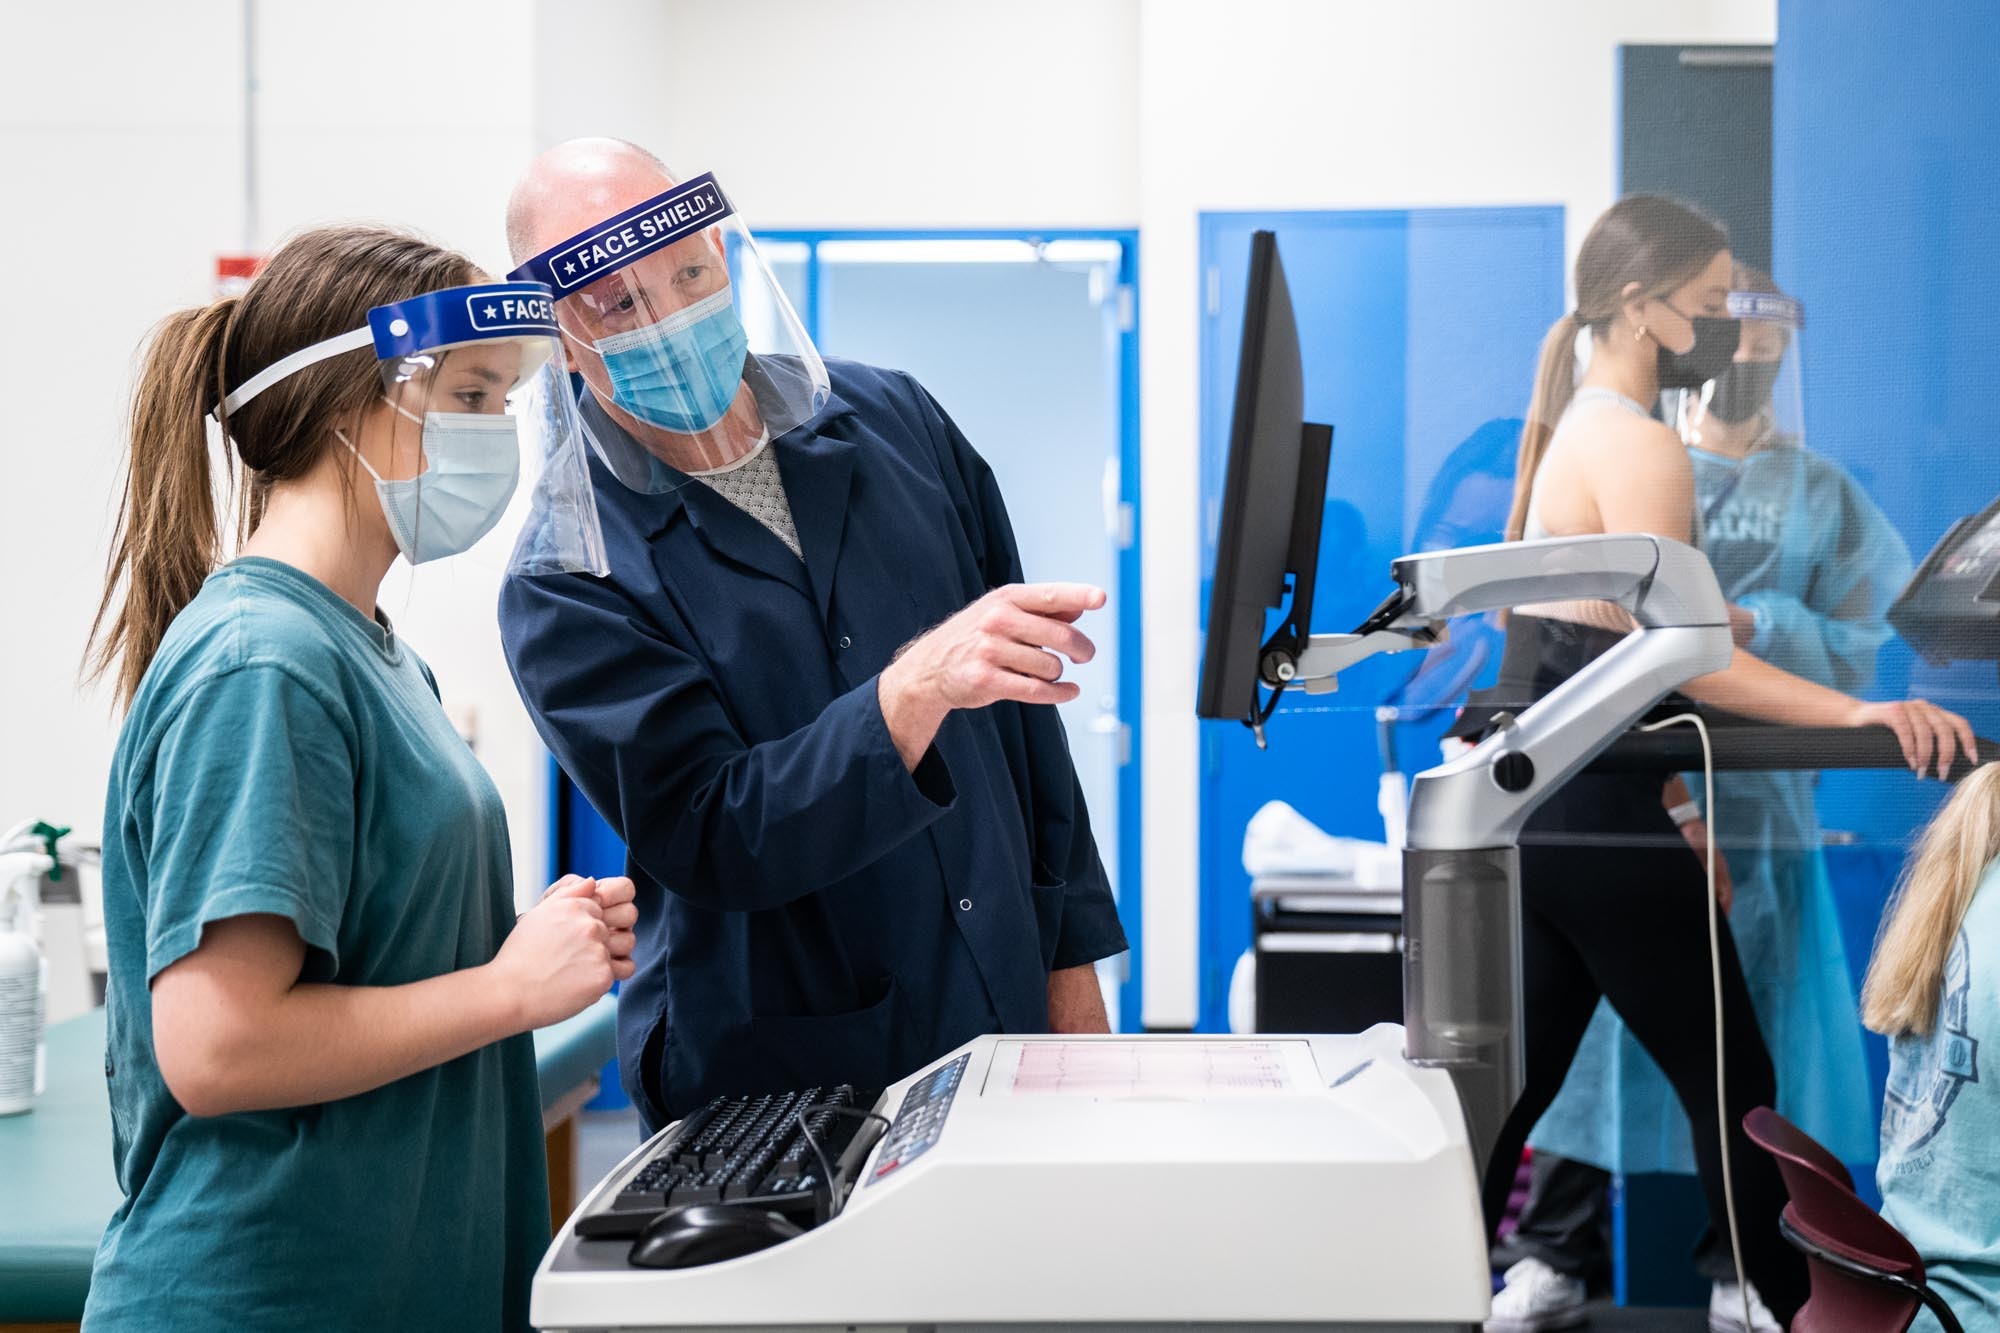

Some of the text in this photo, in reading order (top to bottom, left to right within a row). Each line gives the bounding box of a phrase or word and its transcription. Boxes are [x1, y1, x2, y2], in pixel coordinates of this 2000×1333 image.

[577, 195, 706, 269] FACE SHIELD
[502, 299, 549, 320] FACE
